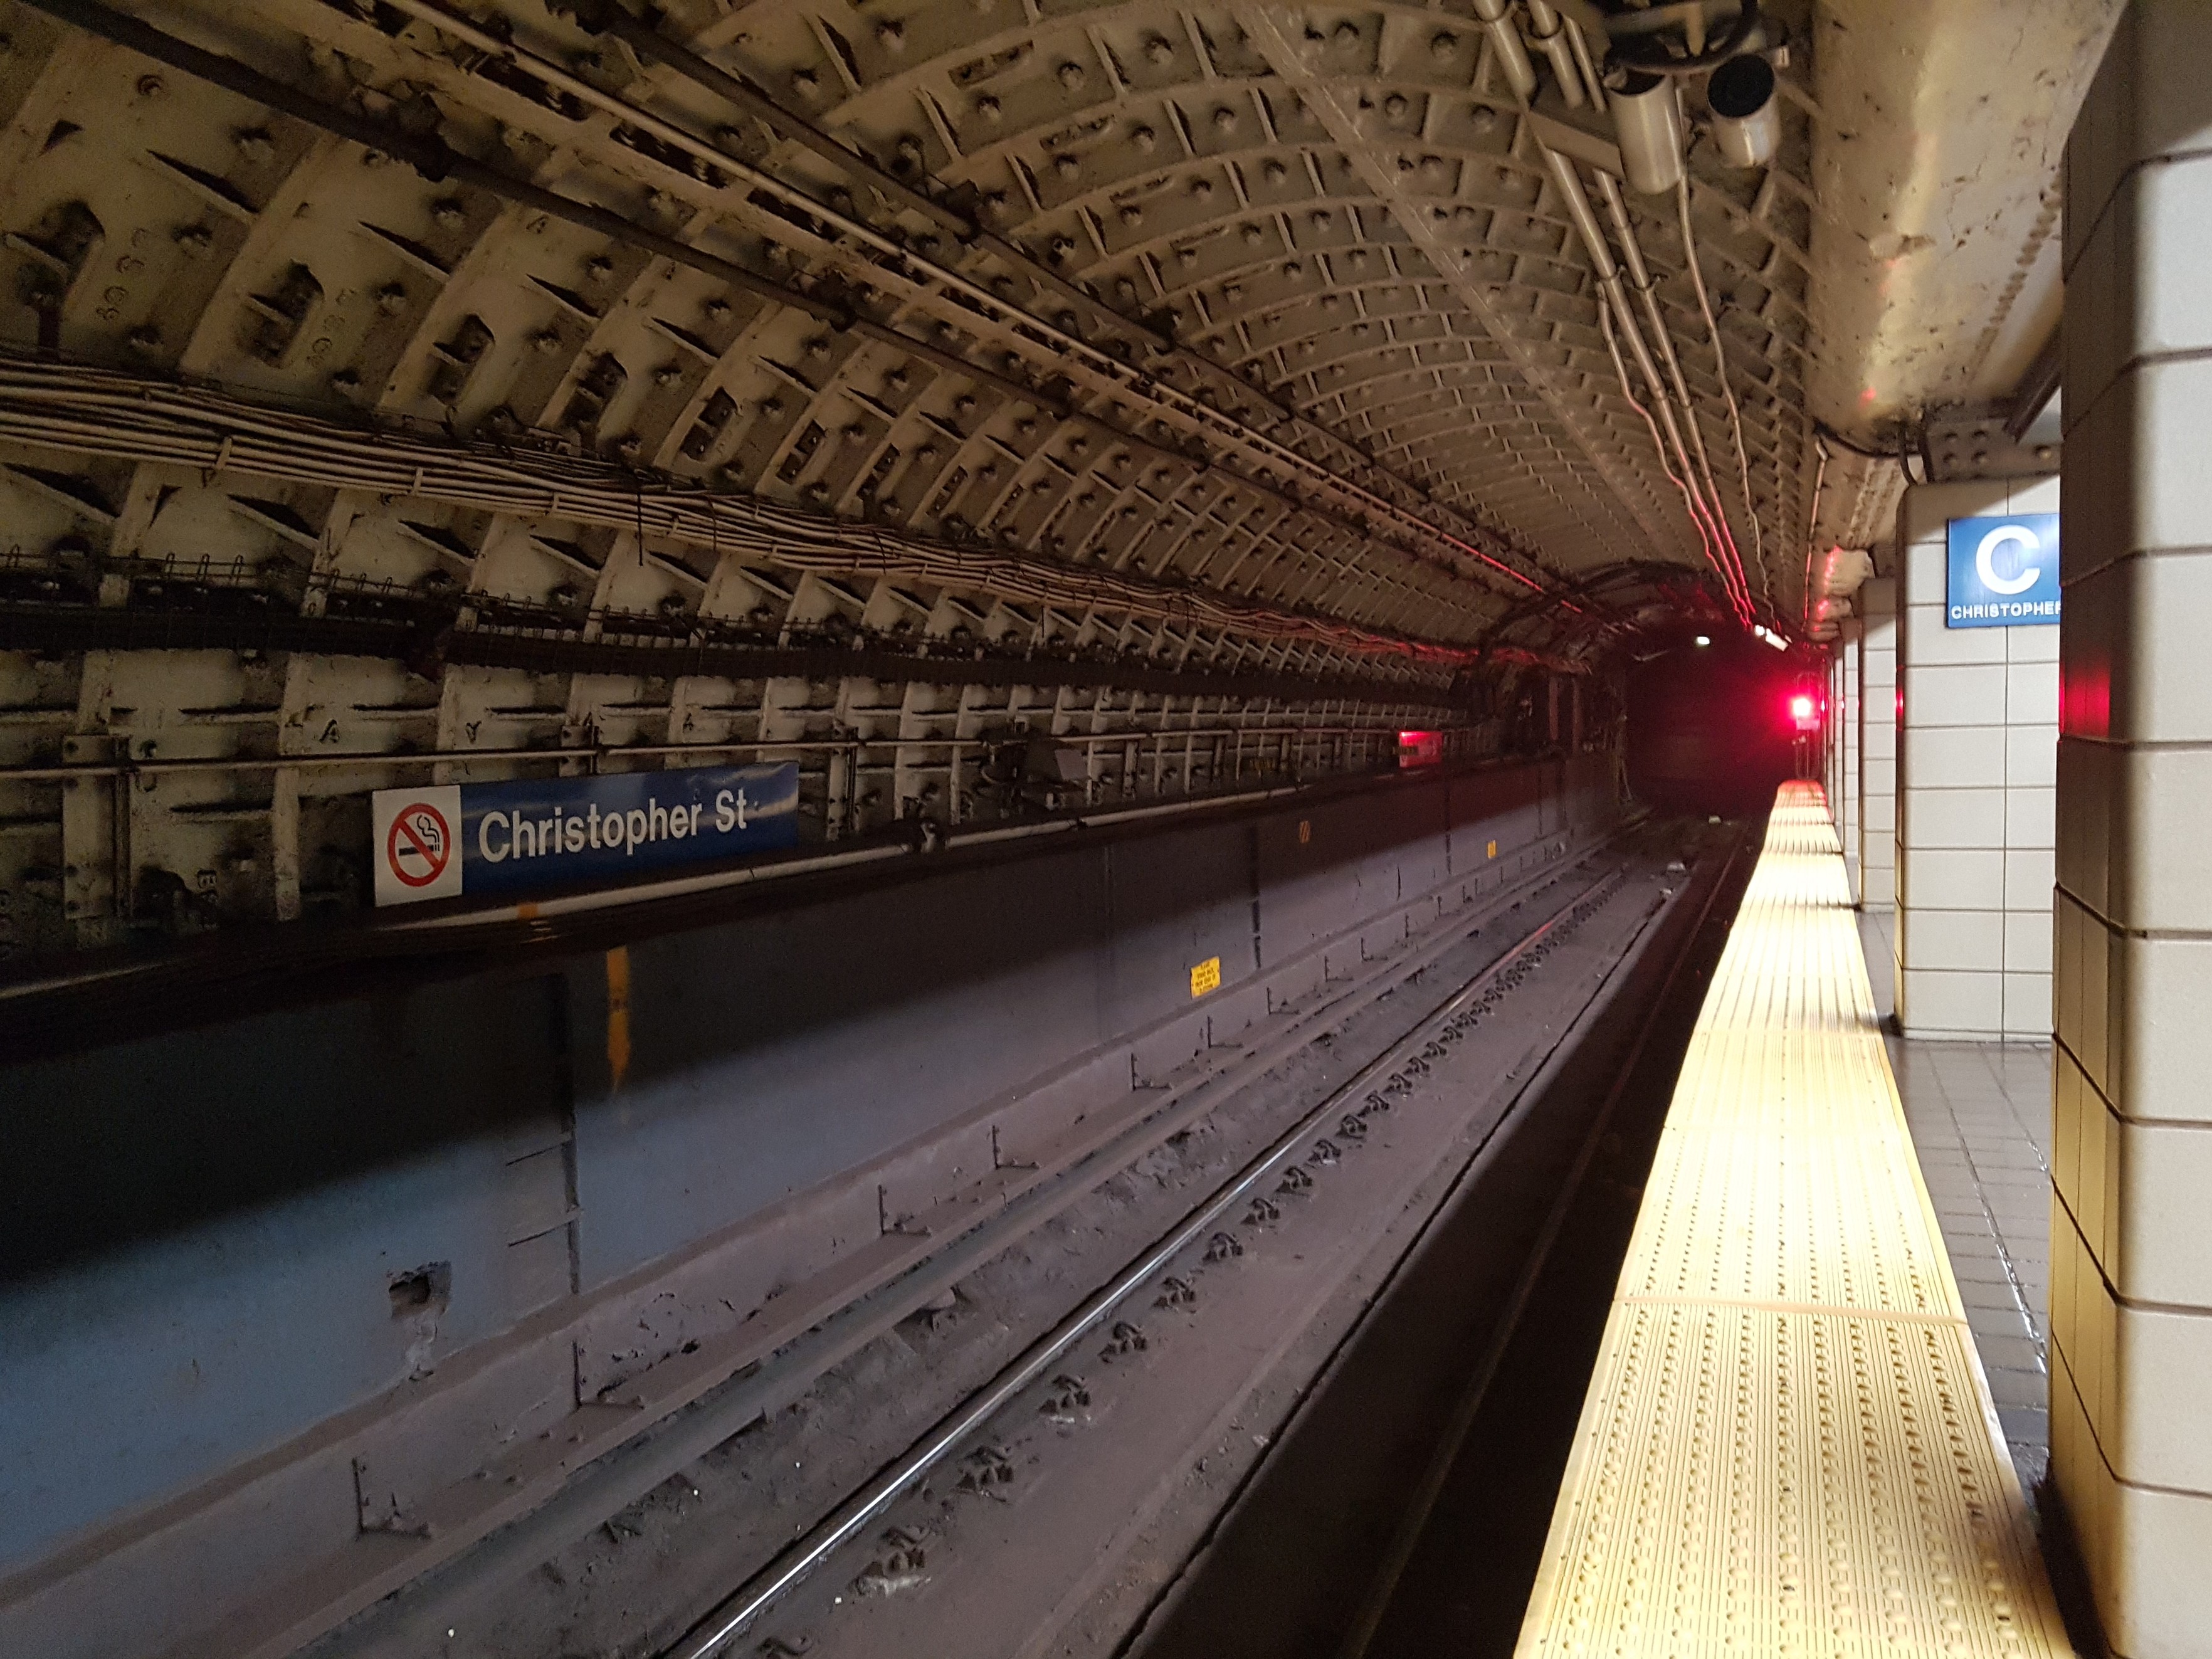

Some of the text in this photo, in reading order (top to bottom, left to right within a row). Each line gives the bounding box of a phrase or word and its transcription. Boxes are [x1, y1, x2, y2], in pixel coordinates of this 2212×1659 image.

[1976, 524, 2041, 595] C
[478, 787, 747, 863] Christopher St
